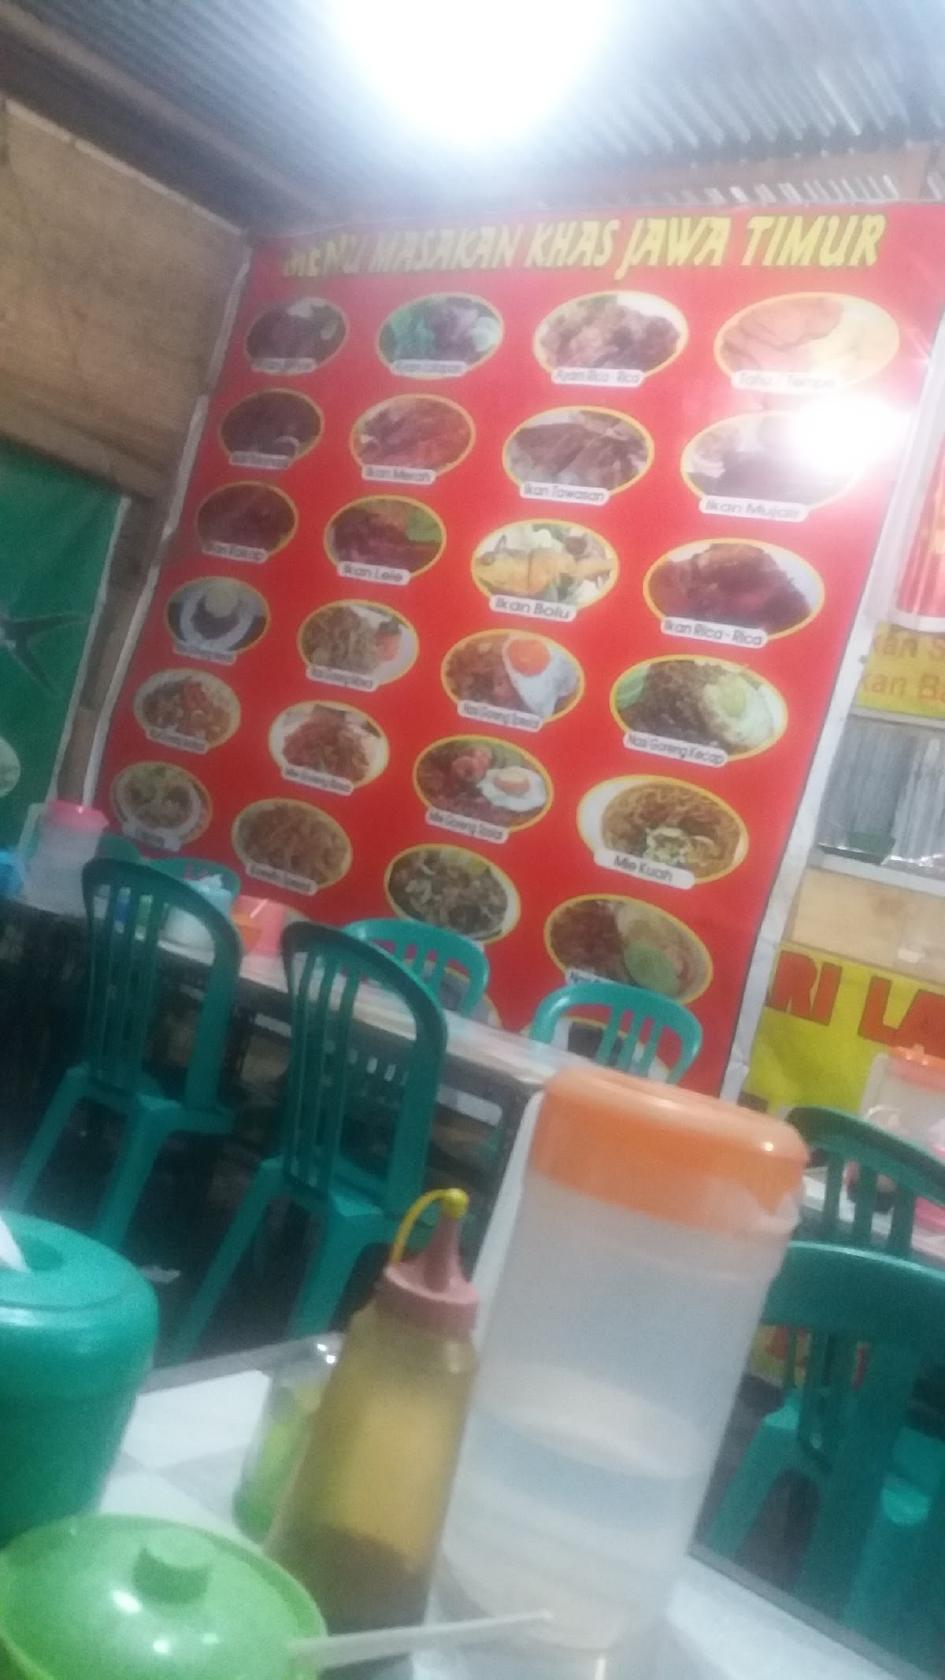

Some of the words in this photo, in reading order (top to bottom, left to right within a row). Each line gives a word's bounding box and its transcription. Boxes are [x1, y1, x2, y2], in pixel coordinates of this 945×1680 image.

[368, 224, 525, 274] MASAKAN
[524, 219, 620, 269] KHAS
[614, 215, 731, 281] JAWA
[741, 213, 887, 269] TIMUR
[706, 500, 742, 513] Ikan
[495, 598, 530, 612] Ikan
[534, 602, 571, 619] Bolu
[664, 619, 692, 634] Ikan
[694, 623, 723, 639] Rica
[733, 629, 763, 646] Rica
[629, 733, 648, 748] Nasi
[648, 737, 688, 758] Goreng
[613, 854, 637, 871] Mie
[639, 861, 674, 882] Kuah
